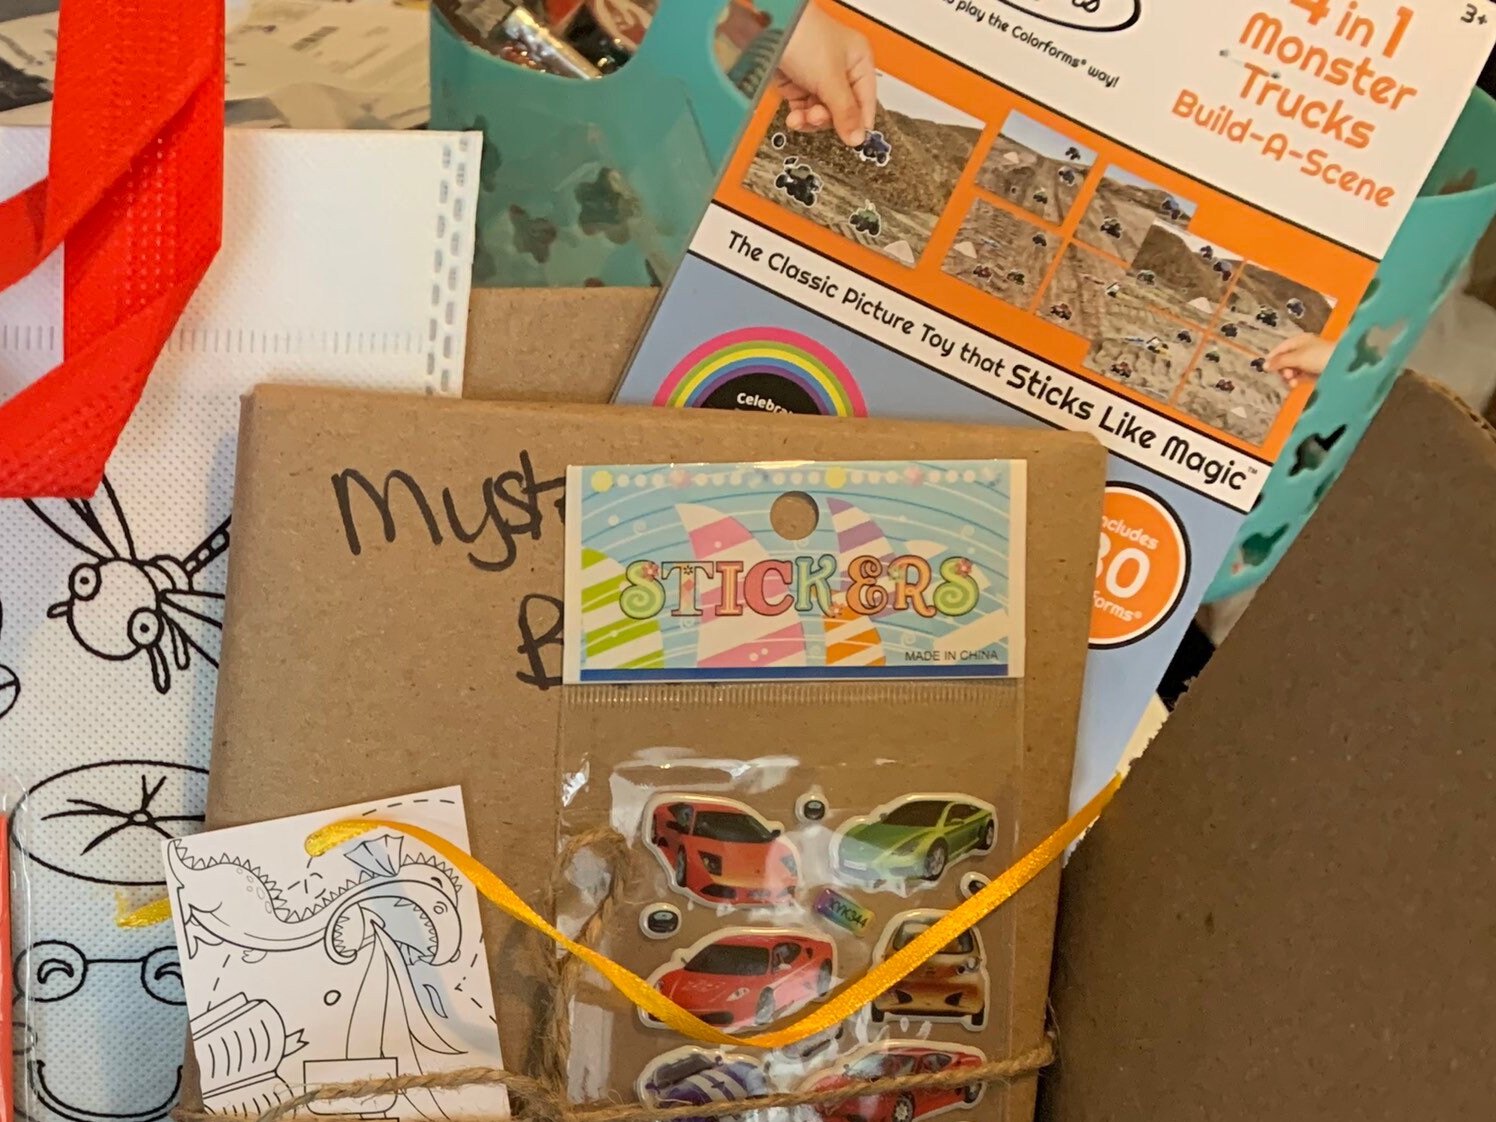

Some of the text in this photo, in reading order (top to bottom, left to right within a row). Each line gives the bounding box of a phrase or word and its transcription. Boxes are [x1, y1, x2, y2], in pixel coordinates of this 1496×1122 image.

[955, 0, 986, 22] play
[989, 13, 1009, 33] the
[1088, 65, 1120, 88] way!
[1335, 2, 1375, 48] in
[1382, 6, 1414, 59] 1
[1460, 3, 1488, 26] 3+
[1238, 11, 1418, 111] Monster
[1240, 61, 1376, 149] Trucks
[1171, 88, 1396, 207] Build-A-Scene
[726, 230, 764, 262] The
[767, 252, 839, 298] Classic
[842, 287, 914, 335] Picture
[920, 323, 955, 357] Toy
[959, 341, 1005, 377] that
[1006, 364, 1095, 421] Sticks
[1098, 405, 1157, 448] Like
[619, 554, 979, 620] STICKERS
[905, 650, 999, 662] MADE IN CHINA
